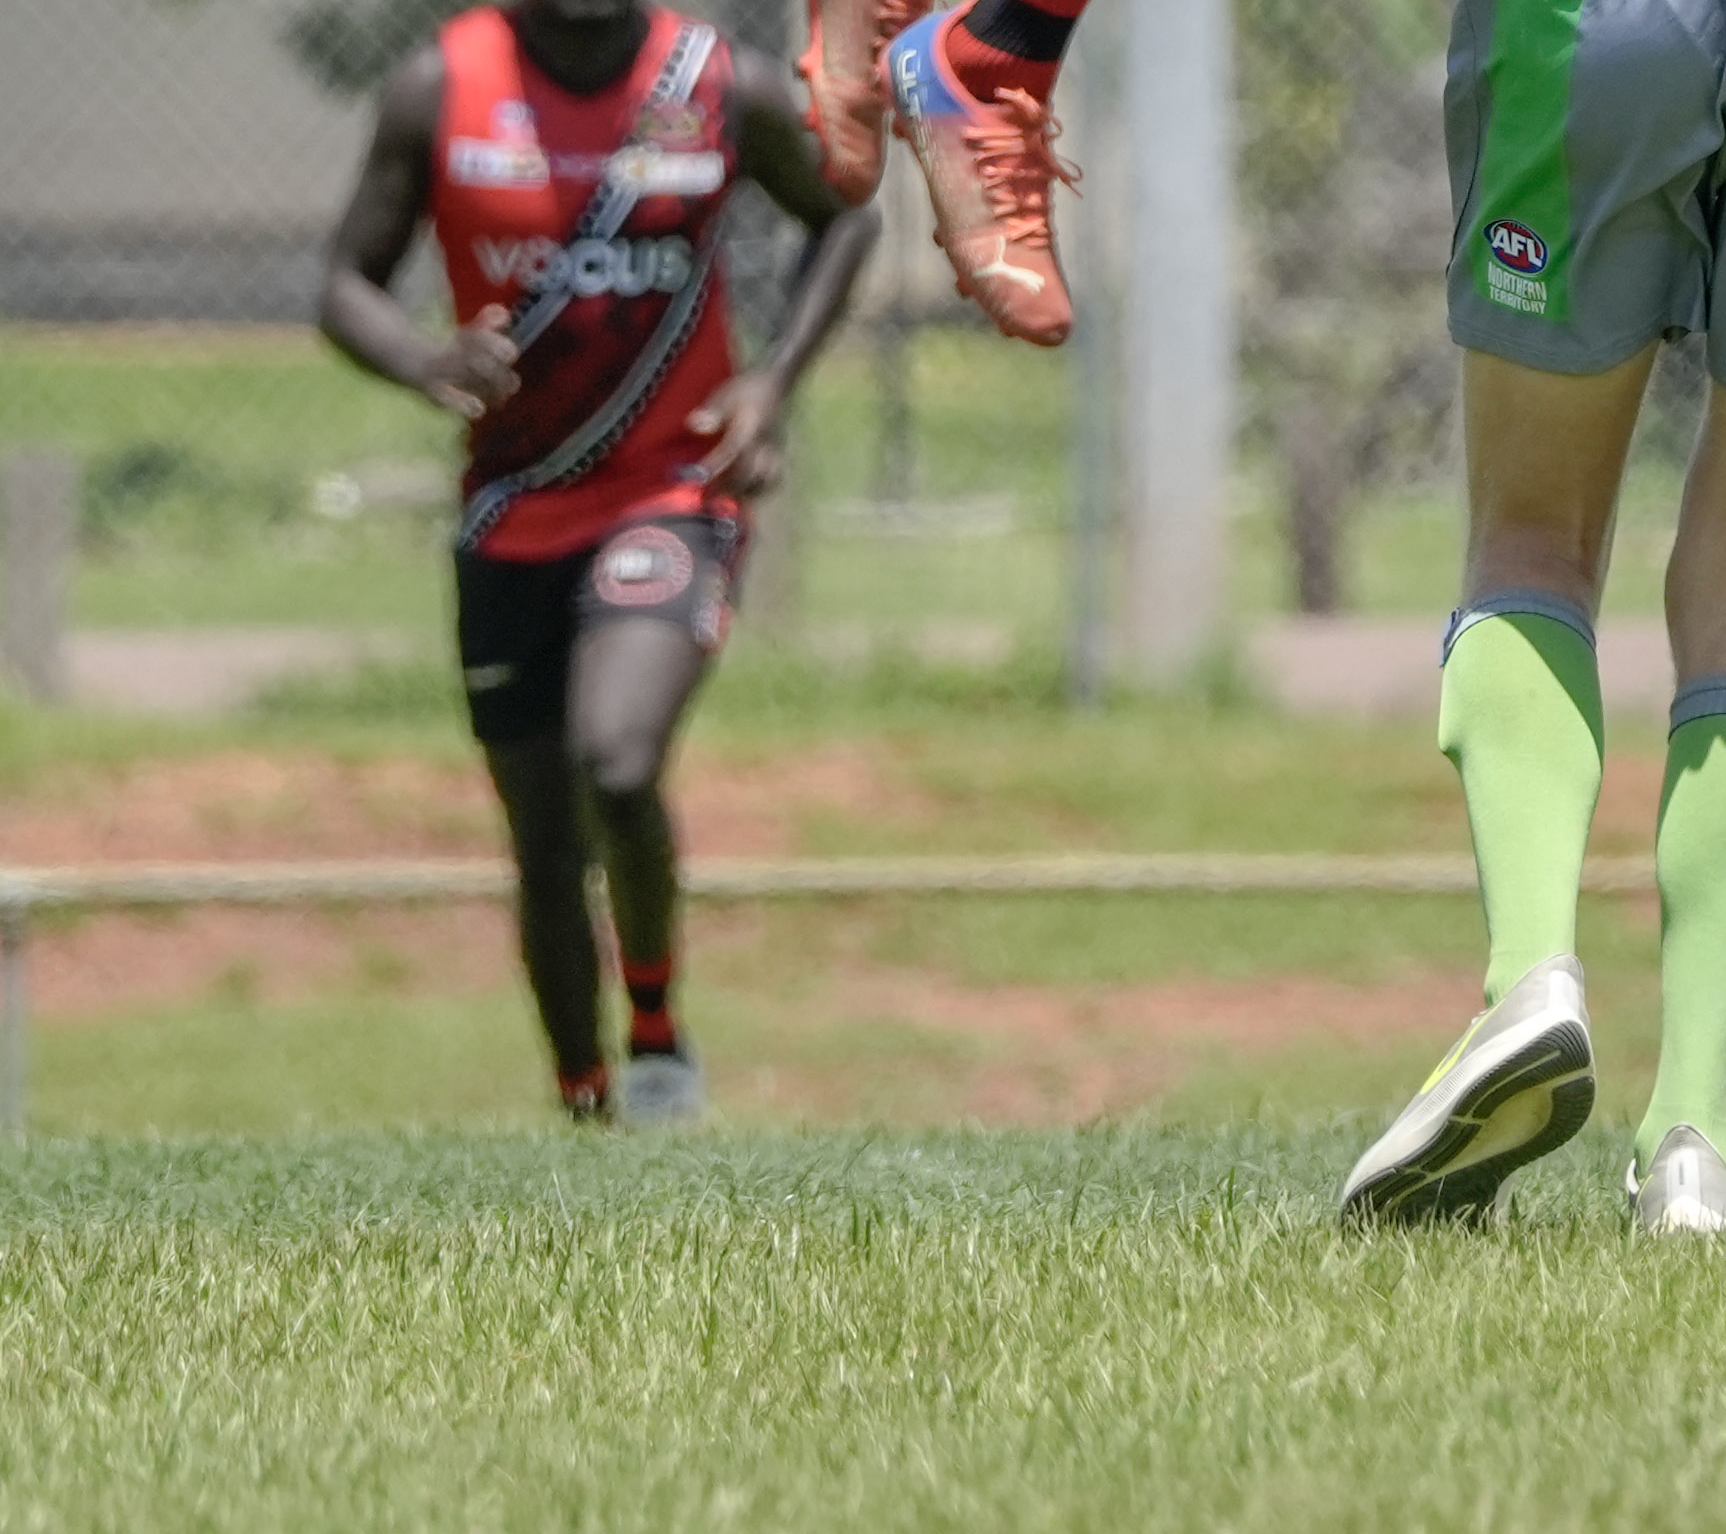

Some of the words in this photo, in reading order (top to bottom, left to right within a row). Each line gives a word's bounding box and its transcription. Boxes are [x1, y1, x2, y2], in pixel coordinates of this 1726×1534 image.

[471, 234, 692, 298] VOCUS
[1491, 225, 1544, 268] AFL
[1487, 261, 1547, 301] NORTHERN
[1489, 285, 1546, 315] TERRITORY
